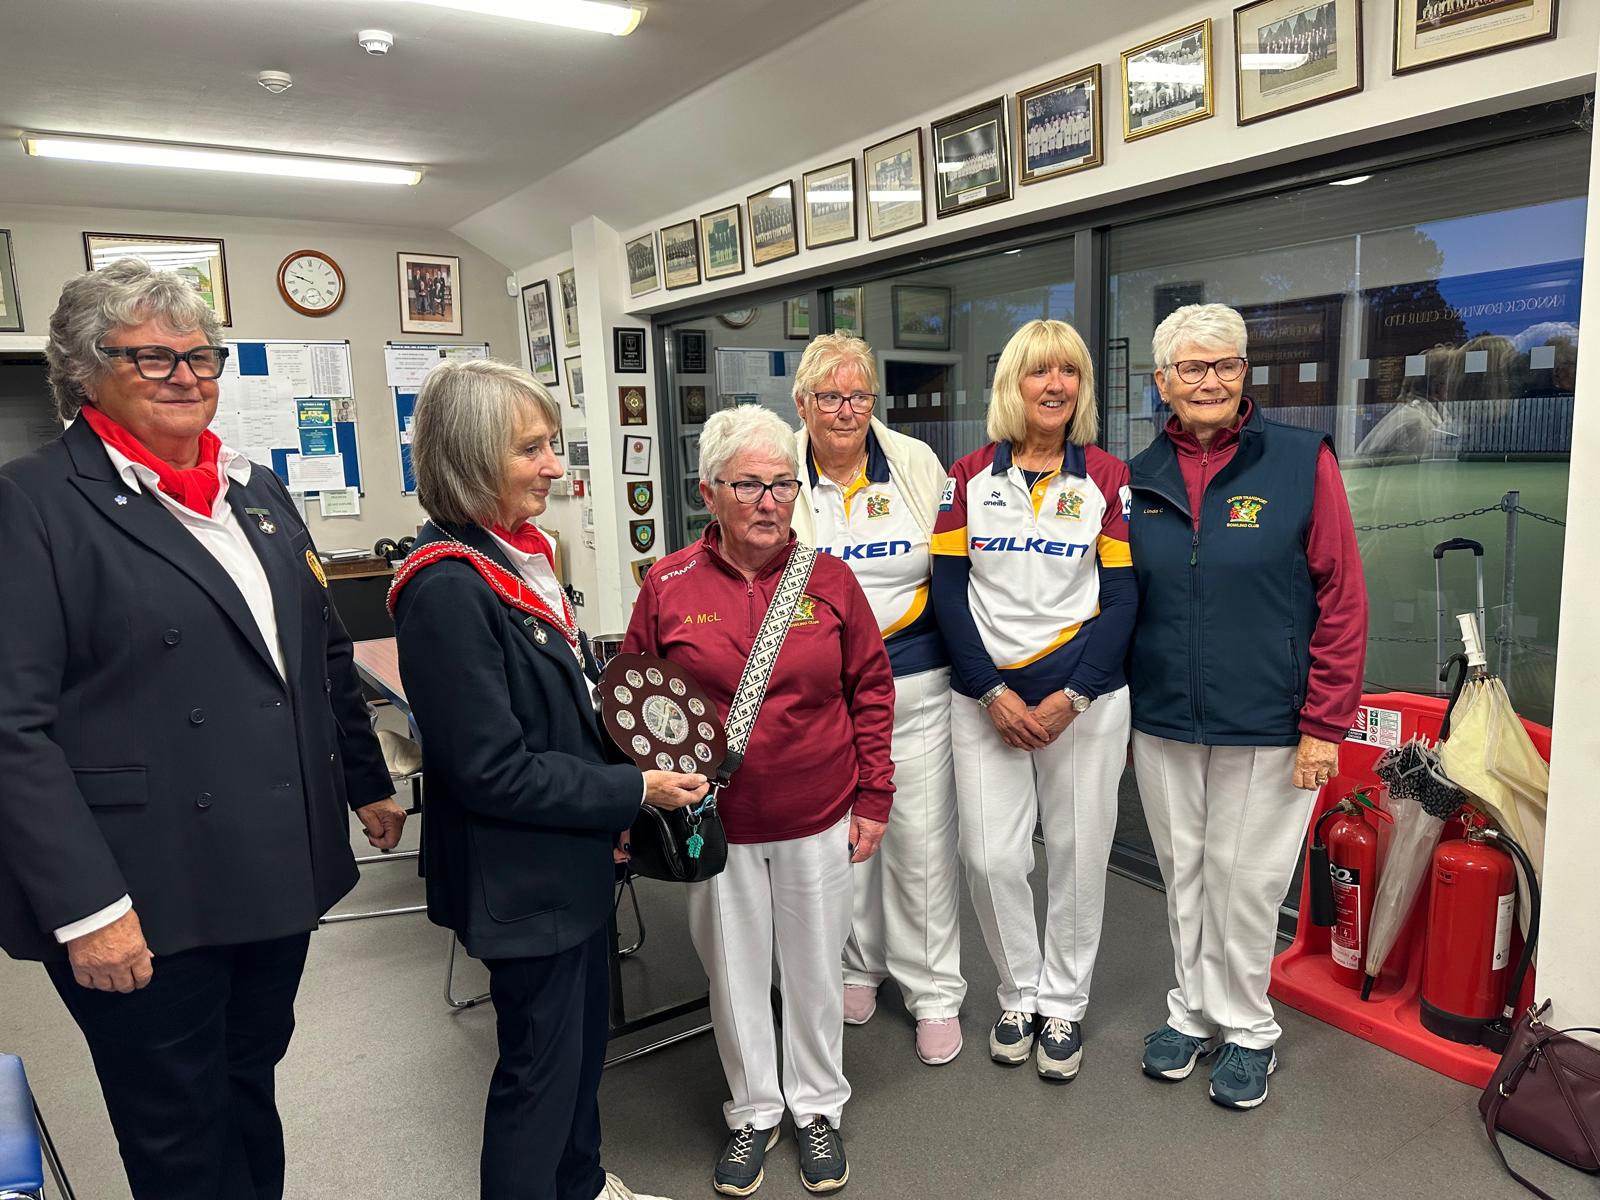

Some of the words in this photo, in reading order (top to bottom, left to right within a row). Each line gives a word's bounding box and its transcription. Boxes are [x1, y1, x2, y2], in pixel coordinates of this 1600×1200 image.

[970, 536, 1090, 558] FALKEN
[660, 560, 697, 582] STANNO
[683, 615, 693, 624] A
[697, 612, 722, 624] McL
